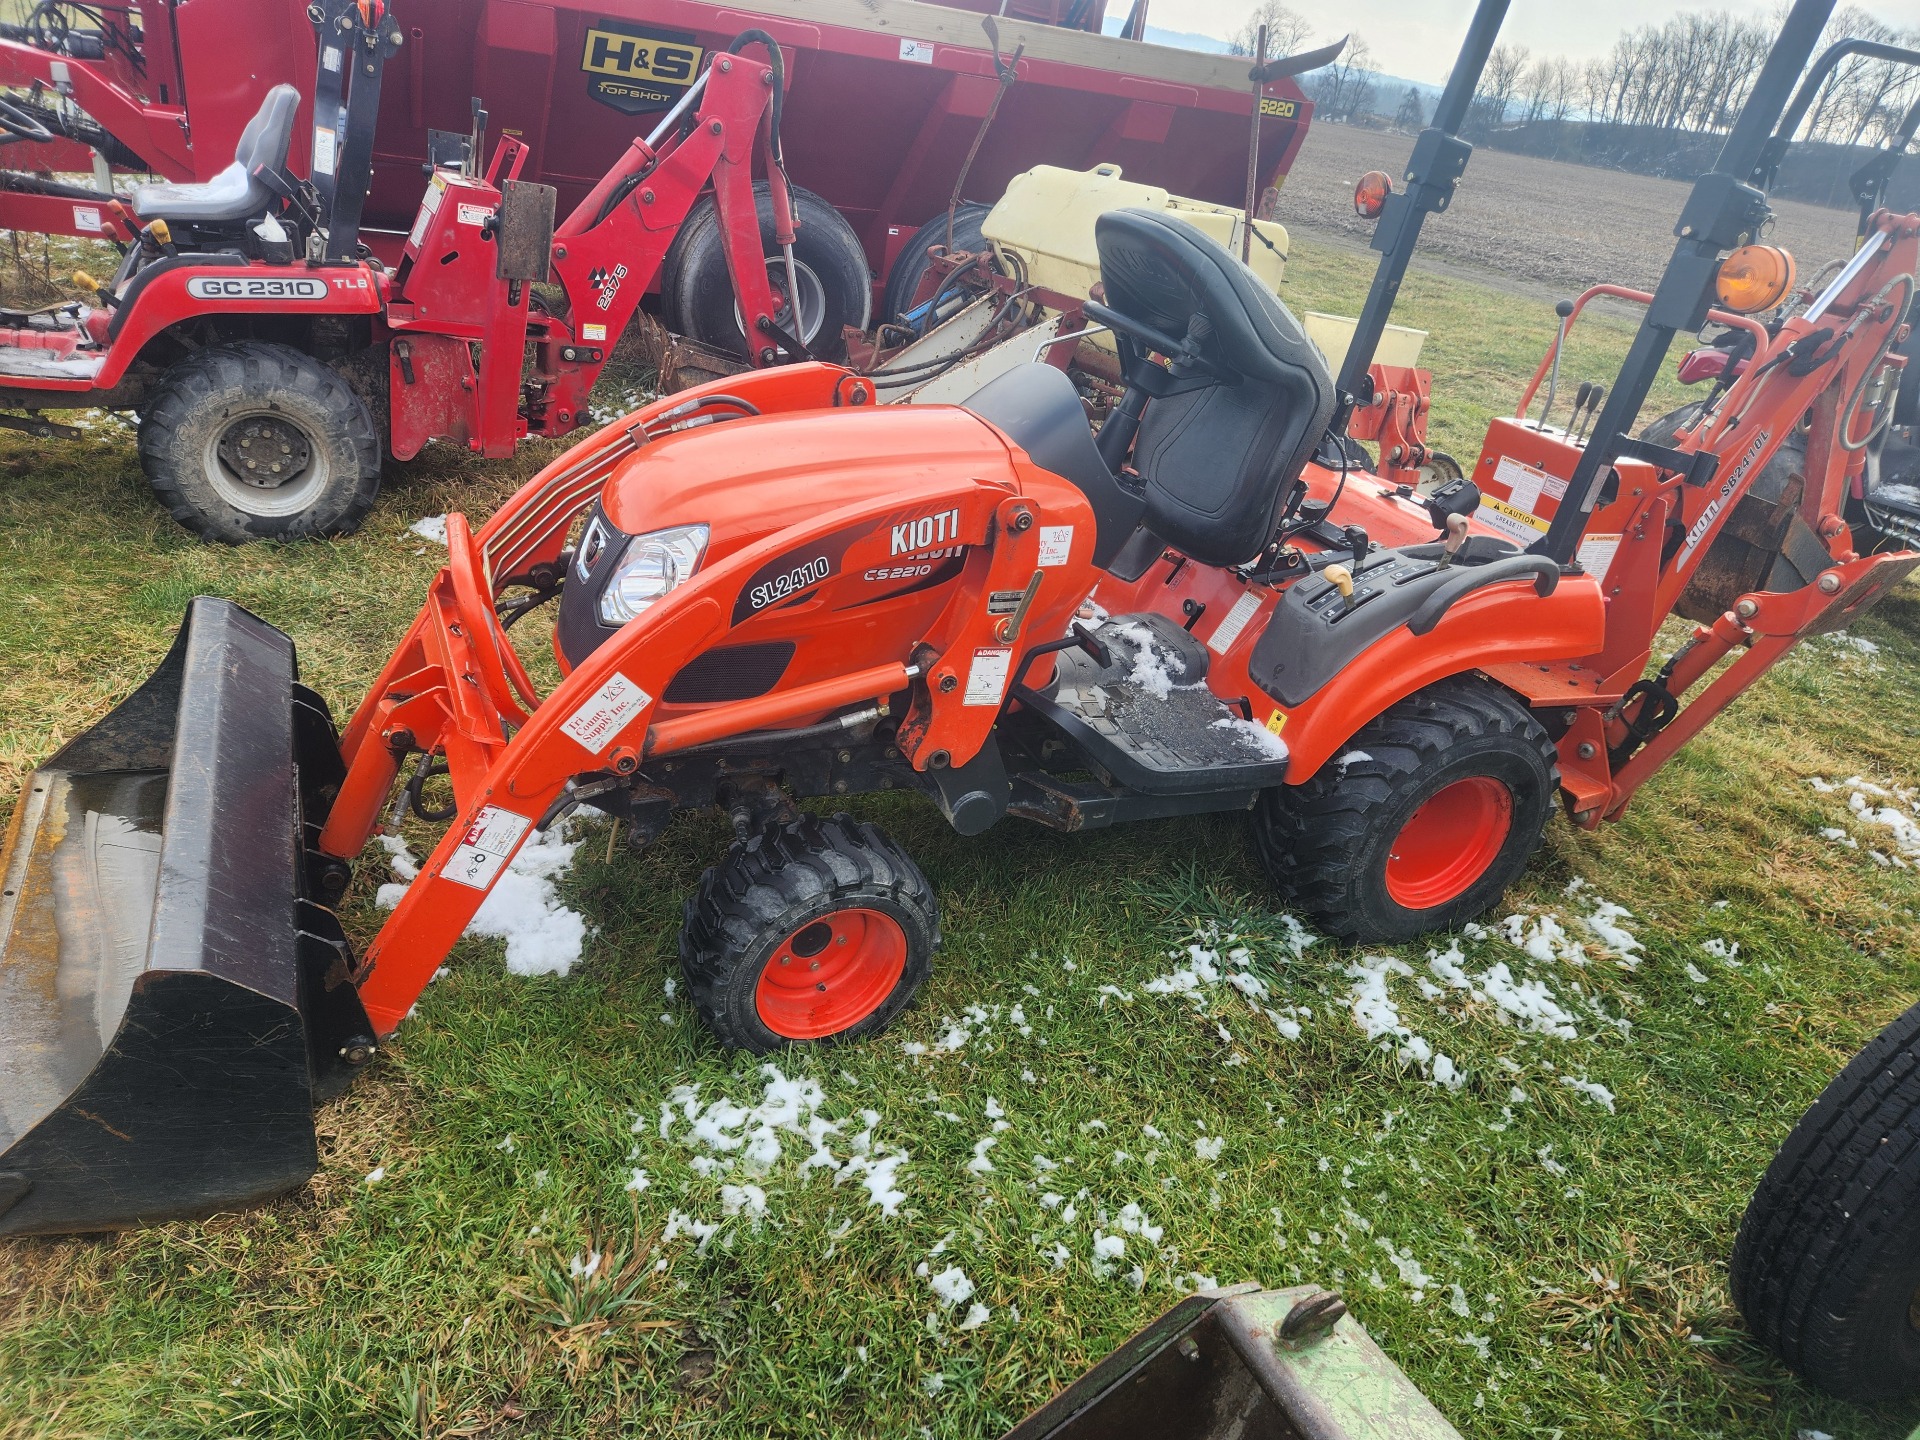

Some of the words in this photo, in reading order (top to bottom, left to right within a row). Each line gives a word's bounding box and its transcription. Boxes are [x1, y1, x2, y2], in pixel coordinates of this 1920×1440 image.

[590, 36, 694, 80] H&S
[598, 84, 628, 99] TOP
[629, 90, 671, 102] SHOT
[1260, 99, 1295, 118] 5220
[202, 281, 243, 295] GC
[247, 281, 315, 296] 2310
[332, 279, 368, 289] TLB
[597, 263, 628, 311] 2375
[1685, 499, 1720, 549] KIOTI
[1721, 430, 1769, 497] SB2410L
[1495, 514, 1516, 529] GREASE
[1503, 506, 1536, 526] CAUTION
[890, 508, 959, 557] KIOTI
[750, 556, 830, 609] SL2410
[863, 564, 932, 581] CS2210
[567, 716, 585, 731] Tri
[575, 708, 607, 737] County
[583, 714, 613, 743] Supply
[610, 700, 630, 716] Inc.
